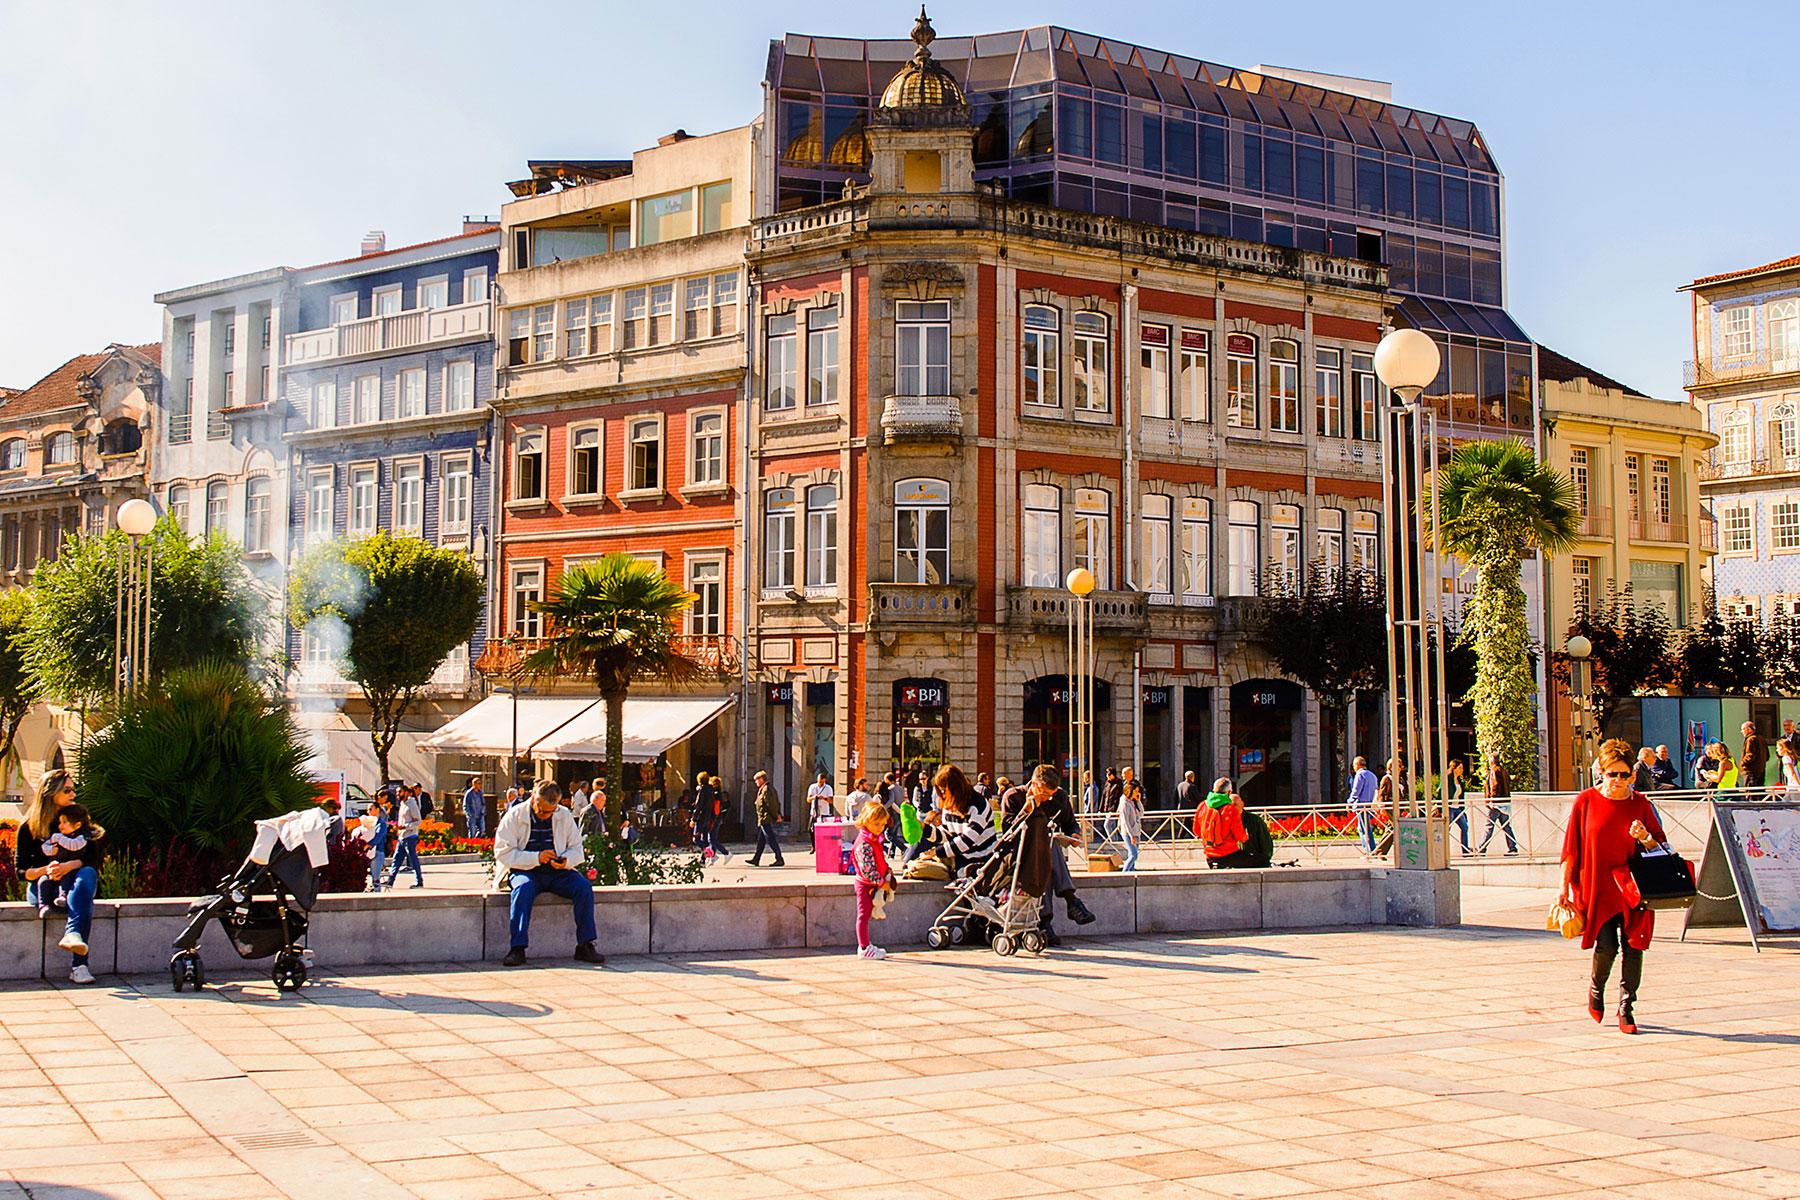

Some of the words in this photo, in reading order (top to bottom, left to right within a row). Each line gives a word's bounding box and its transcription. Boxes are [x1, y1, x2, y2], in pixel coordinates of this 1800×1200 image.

[1456, 577, 1478, 595] LUS
[780, 688, 793, 700] BP
[918, 688, 941, 701] BPI
[1151, 691, 1167, 704] BPI
[1261, 693, 1276, 705] BPI
